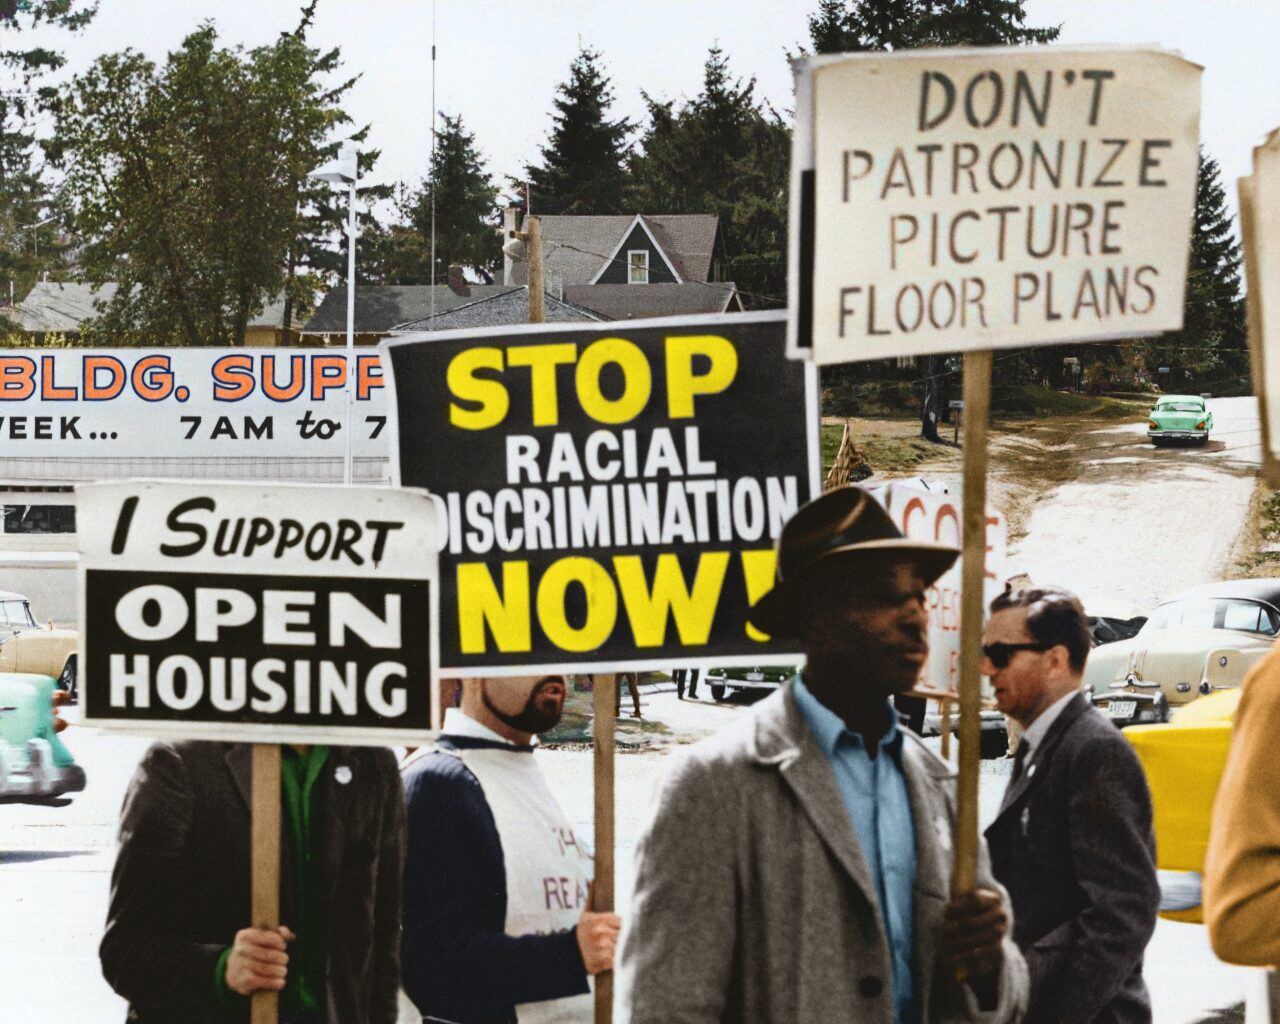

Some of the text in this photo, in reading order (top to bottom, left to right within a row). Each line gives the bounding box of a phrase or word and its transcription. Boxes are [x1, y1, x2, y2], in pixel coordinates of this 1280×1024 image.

[917, 70, 1115, 132] DON'T
[842, 139, 1172, 202] PATRONIZE
[889, 201, 1125, 270] PICTURE
[838, 265, 1160, 338] FLOOR PLANS
[0, 354, 190, 403] BLDG.
[446, 335, 738, 430] STOP
[0, 411, 387, 440] EEK... 7AM to 7
[506, 427, 716, 484] RACIAL
[111, 496, 140, 555] I
[115, 584, 401, 649] OPEN
[110, 654, 407, 718] HOUSING
